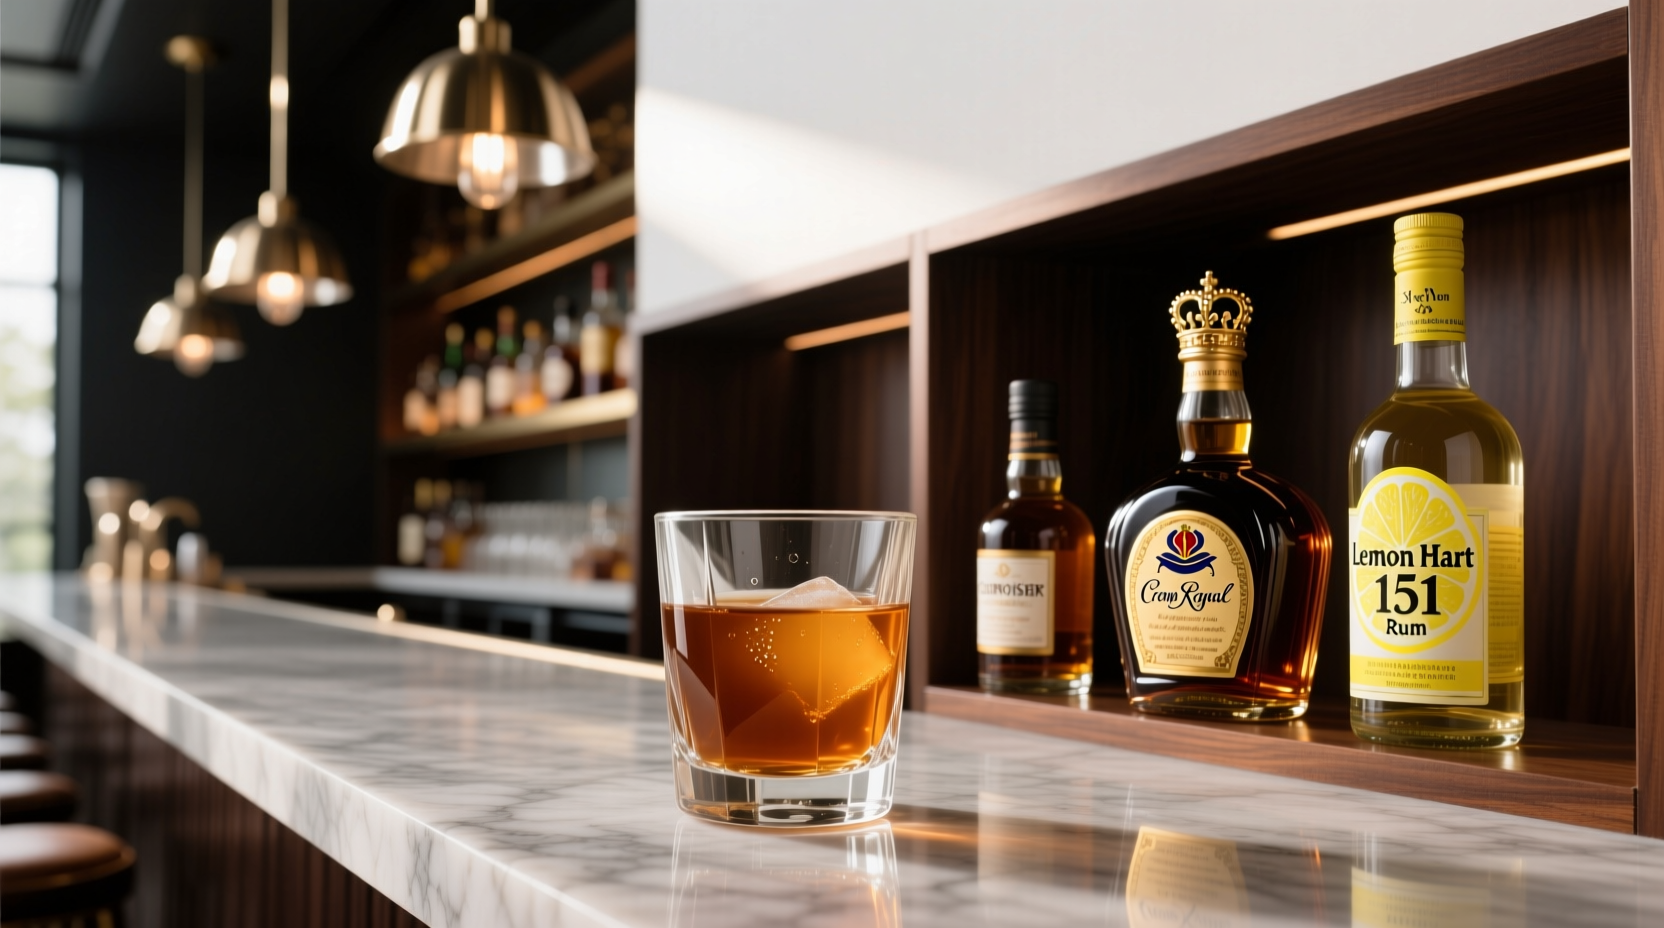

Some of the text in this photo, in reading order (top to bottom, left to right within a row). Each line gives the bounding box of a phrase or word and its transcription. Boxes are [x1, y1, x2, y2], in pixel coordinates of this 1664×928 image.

[1353, 542, 1474, 568] Lemon Hart
[1375, 573, 1441, 615] 151
[1386, 618, 1427, 636] Rum
